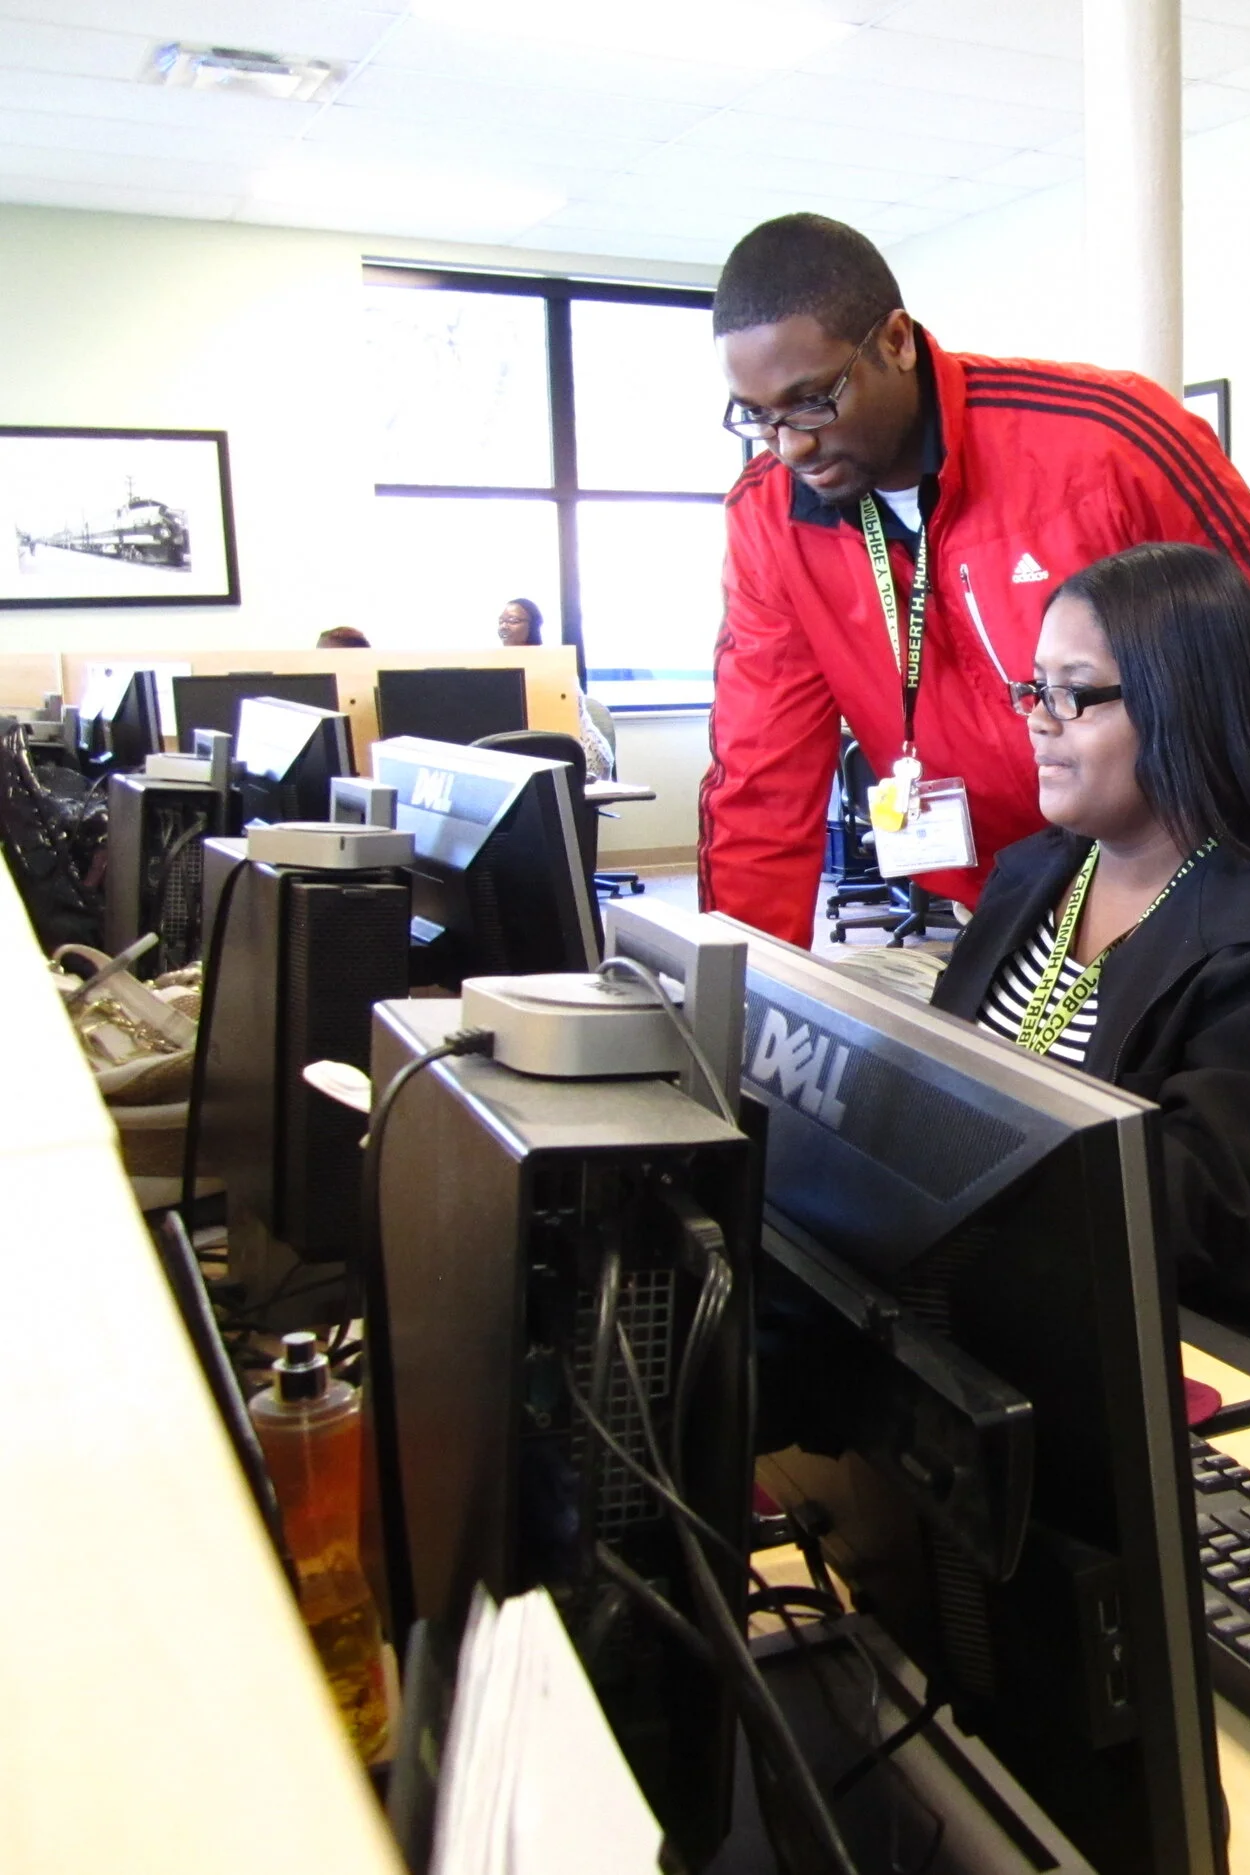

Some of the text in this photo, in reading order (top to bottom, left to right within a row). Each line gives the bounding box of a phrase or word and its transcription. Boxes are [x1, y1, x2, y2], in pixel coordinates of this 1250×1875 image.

[912, 593, 926, 610] H.
[906, 614, 923, 688] HUBERT
[411, 767, 455, 813] DELL
[751, 1007, 850, 1131] DELL
